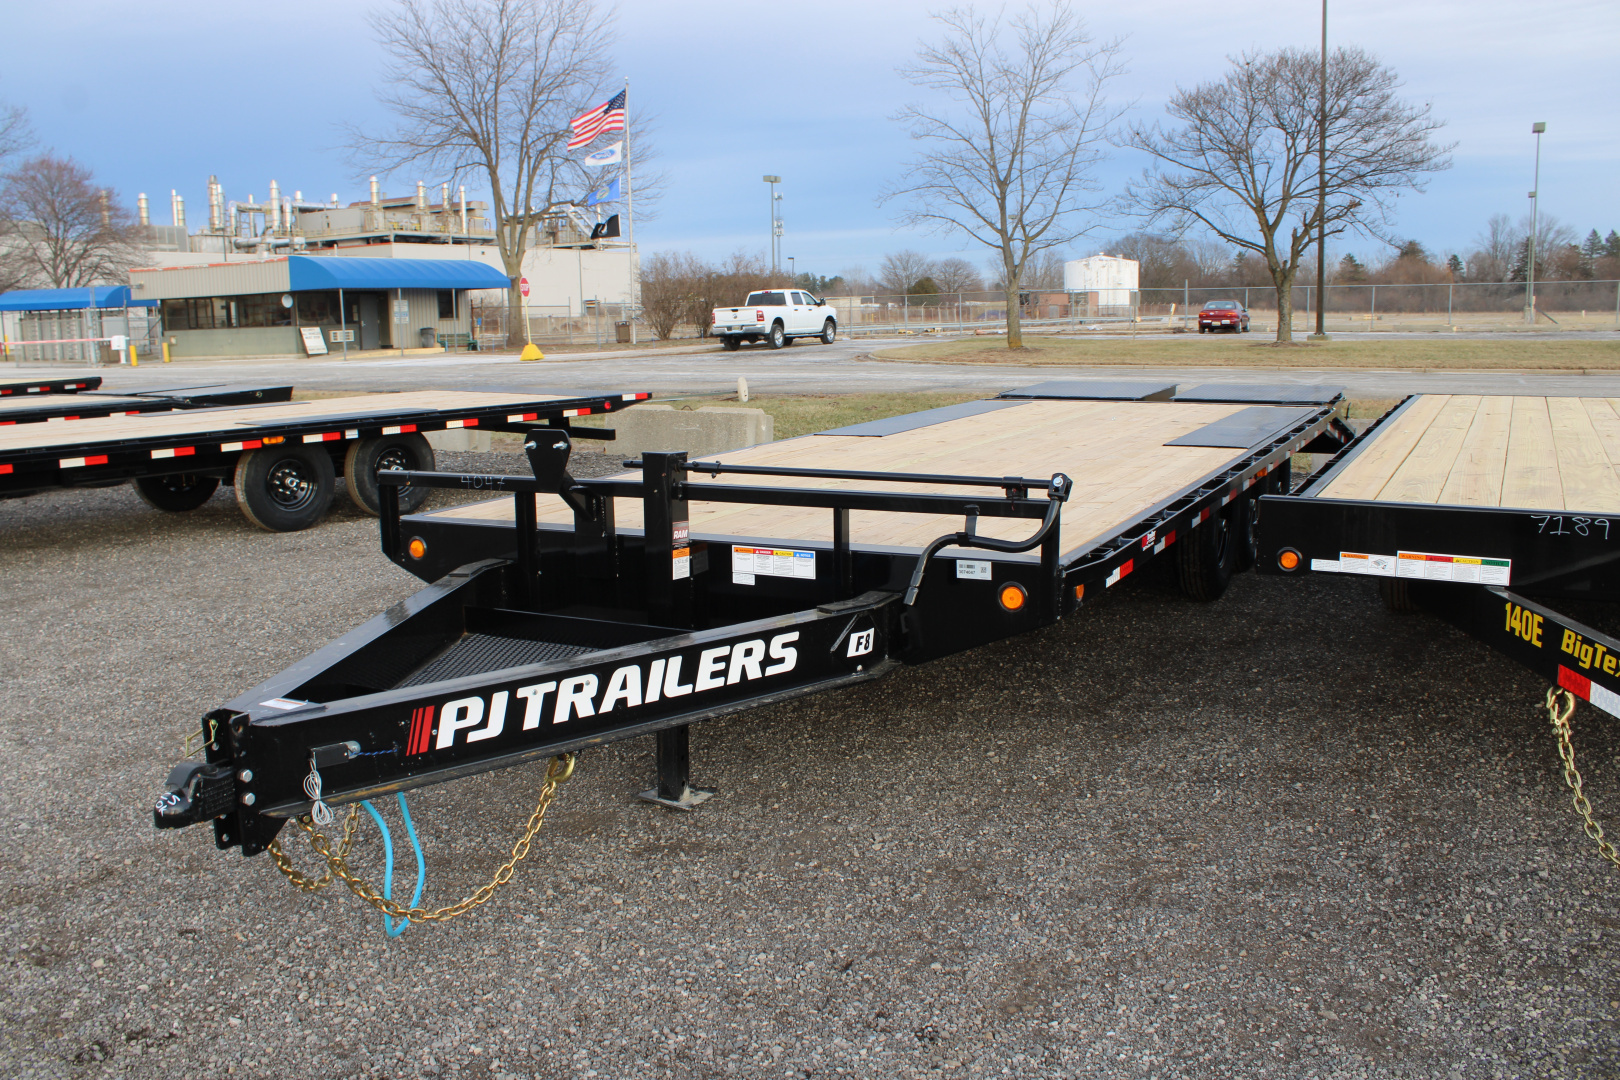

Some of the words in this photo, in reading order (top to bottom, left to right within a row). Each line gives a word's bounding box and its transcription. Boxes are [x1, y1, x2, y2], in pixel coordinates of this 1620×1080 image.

[461, 475, 505, 490] 4047
[673, 529, 688, 540] RAM
[1530, 515, 1610, 540] 7189
[1505, 602, 1544, 648] 140E
[855, 633, 871, 653] F8
[435, 690, 509, 750] PJ
[517, 631, 800, 731] TRAILERS
